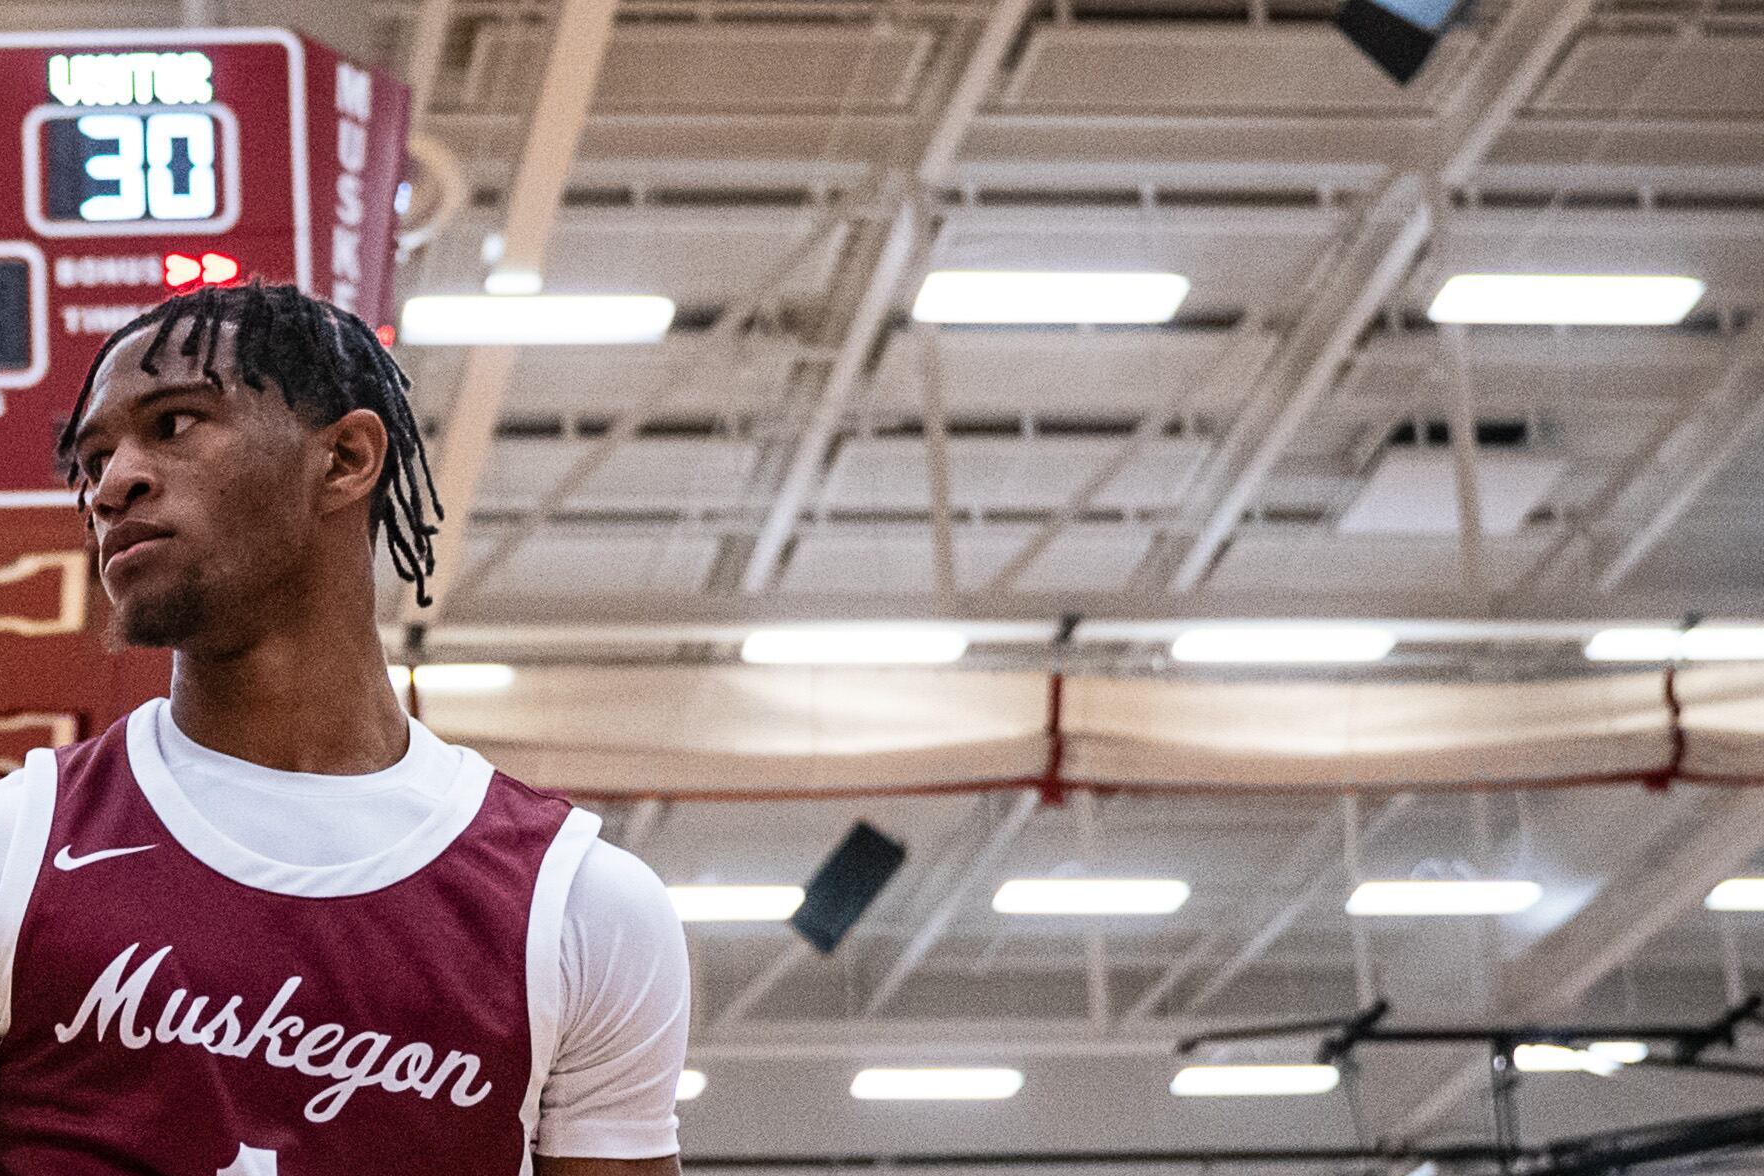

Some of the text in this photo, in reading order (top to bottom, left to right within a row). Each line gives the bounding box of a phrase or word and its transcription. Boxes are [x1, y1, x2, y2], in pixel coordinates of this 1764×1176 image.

[78, 113, 215, 221] 30
[55, 256, 162, 287] BONUS
[54, 942, 492, 1123] Muskegon
